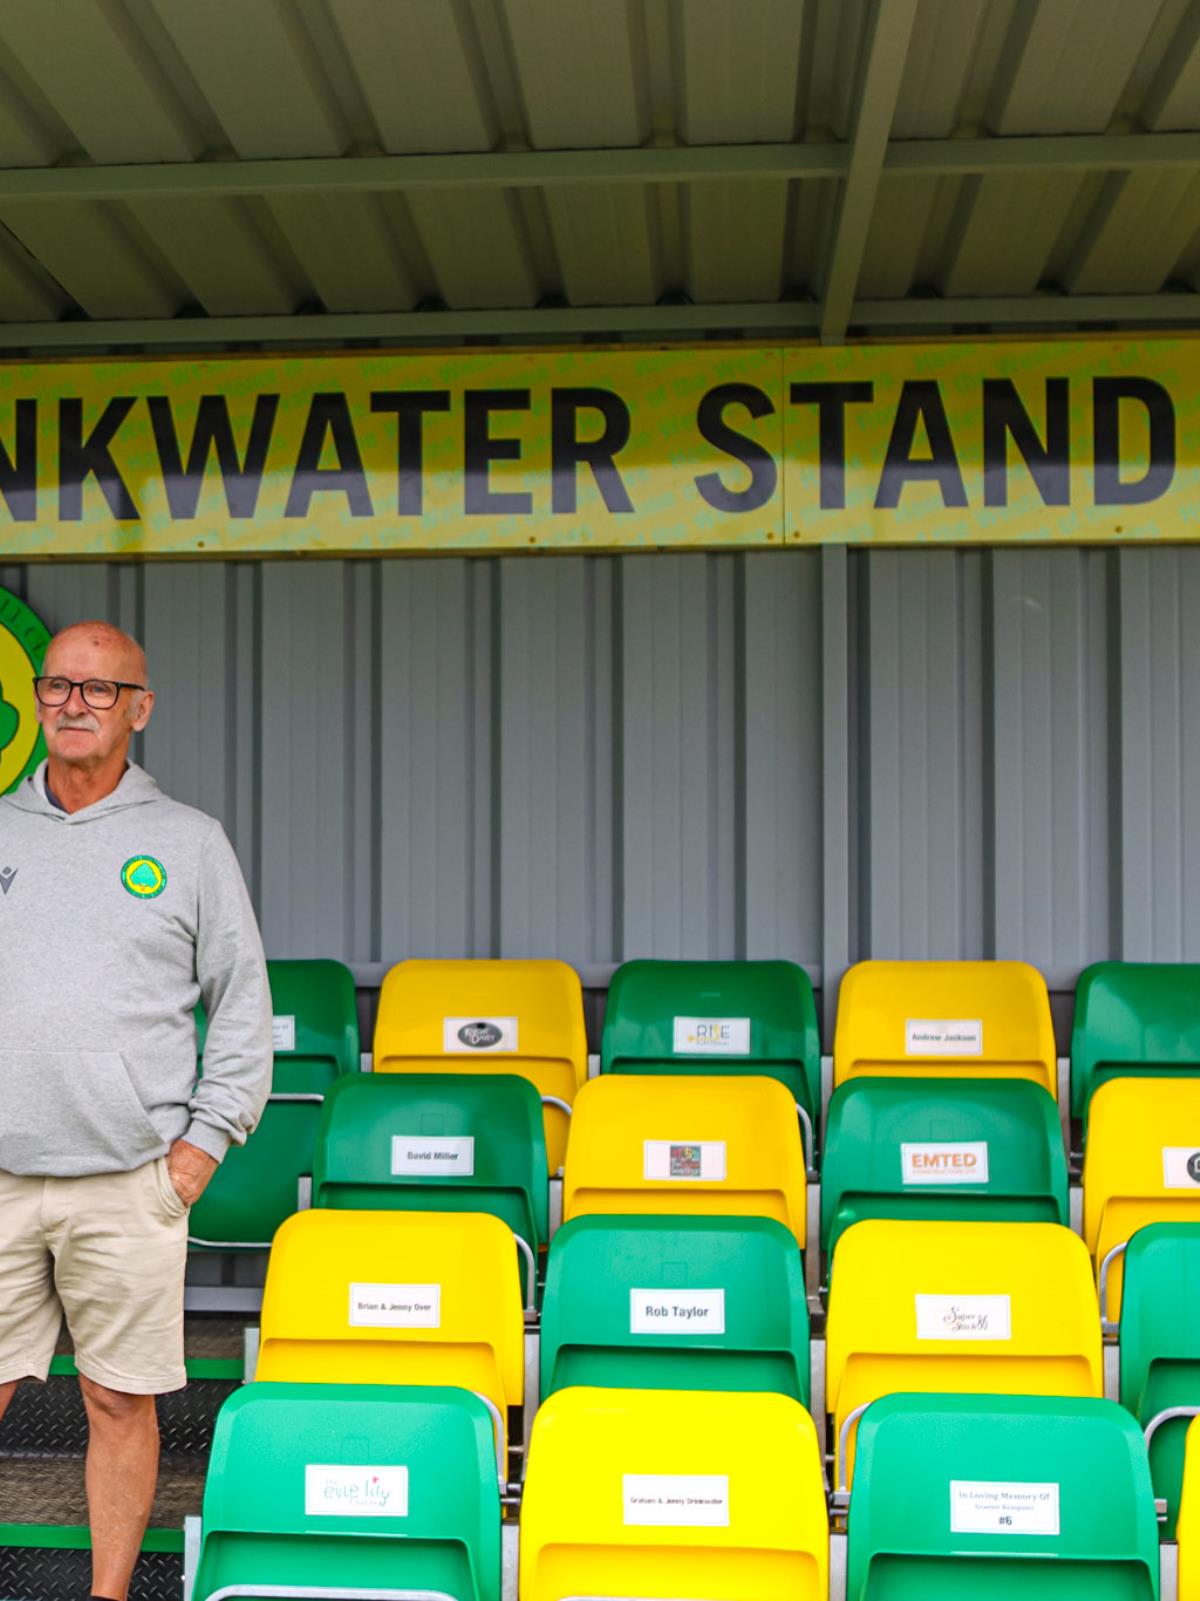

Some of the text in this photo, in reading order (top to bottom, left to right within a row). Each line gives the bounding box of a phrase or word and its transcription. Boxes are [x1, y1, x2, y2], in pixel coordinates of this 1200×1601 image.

[694, 376, 1176, 513] STAND
[407, 1151, 459, 1161] David Miller
[911, 1152, 977, 1168] EMTED
[645, 1305, 709, 1319] Rob Taylor
[1001, 1492, 1037, 1502] Memory
[998, 1515, 1013, 1526] #6
